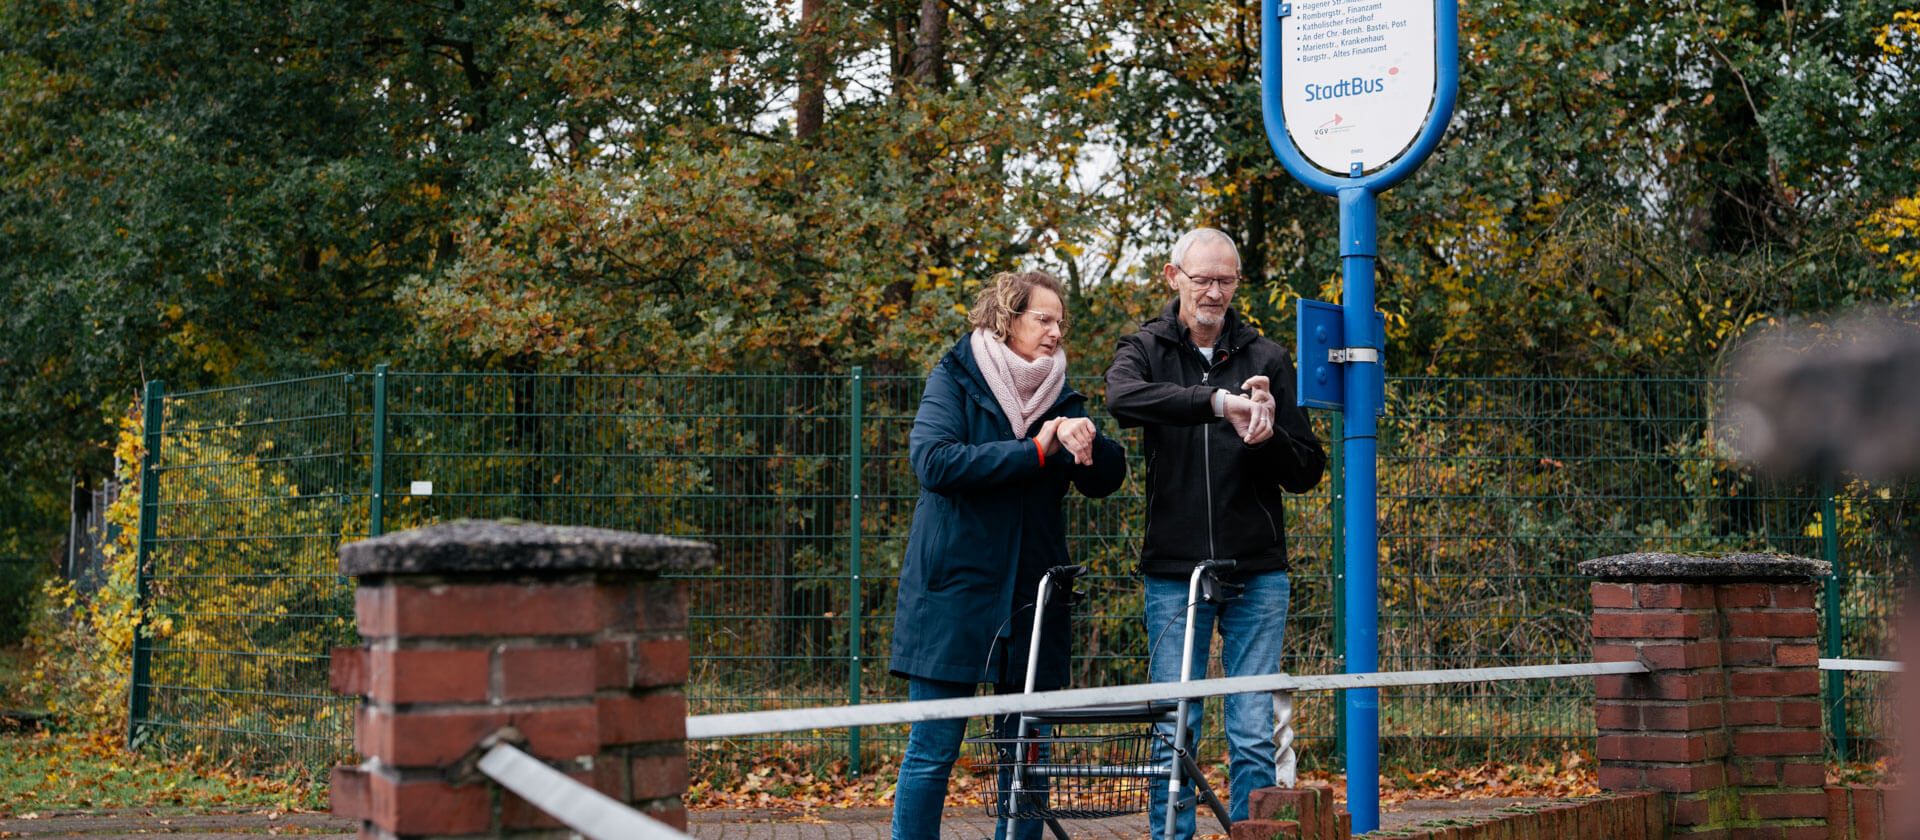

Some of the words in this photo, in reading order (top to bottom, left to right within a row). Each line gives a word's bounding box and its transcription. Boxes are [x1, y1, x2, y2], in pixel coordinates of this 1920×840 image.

[1302, 1, 1331, 11] Hagener
[1302, 10, 1346, 20] Rombergstr.,
[1347, 3, 1382, 13] Finanzamt
[1302, 20, 1344, 31] Katholischer
[1345, 14, 1374, 24] Friedhof
[1313, 32, 1325, 40] der
[1326, 27, 1364, 38] Chr.-Bernh.
[1366, 23, 1390, 33] Bastei,
[1391, 20, 1407, 28] Post
[1302, 42, 1339, 52] Marienstr.,
[1341, 34, 1385, 46] Krankenhaus
[1302, 54, 1331, 63] Burgstr.,
[1333, 50, 1351, 58] Altes
[1352, 44, 1387, 55] Finanzamt
[1305, 77, 1384, 101] StadtBus
[1314, 128, 1329, 136] VGV
